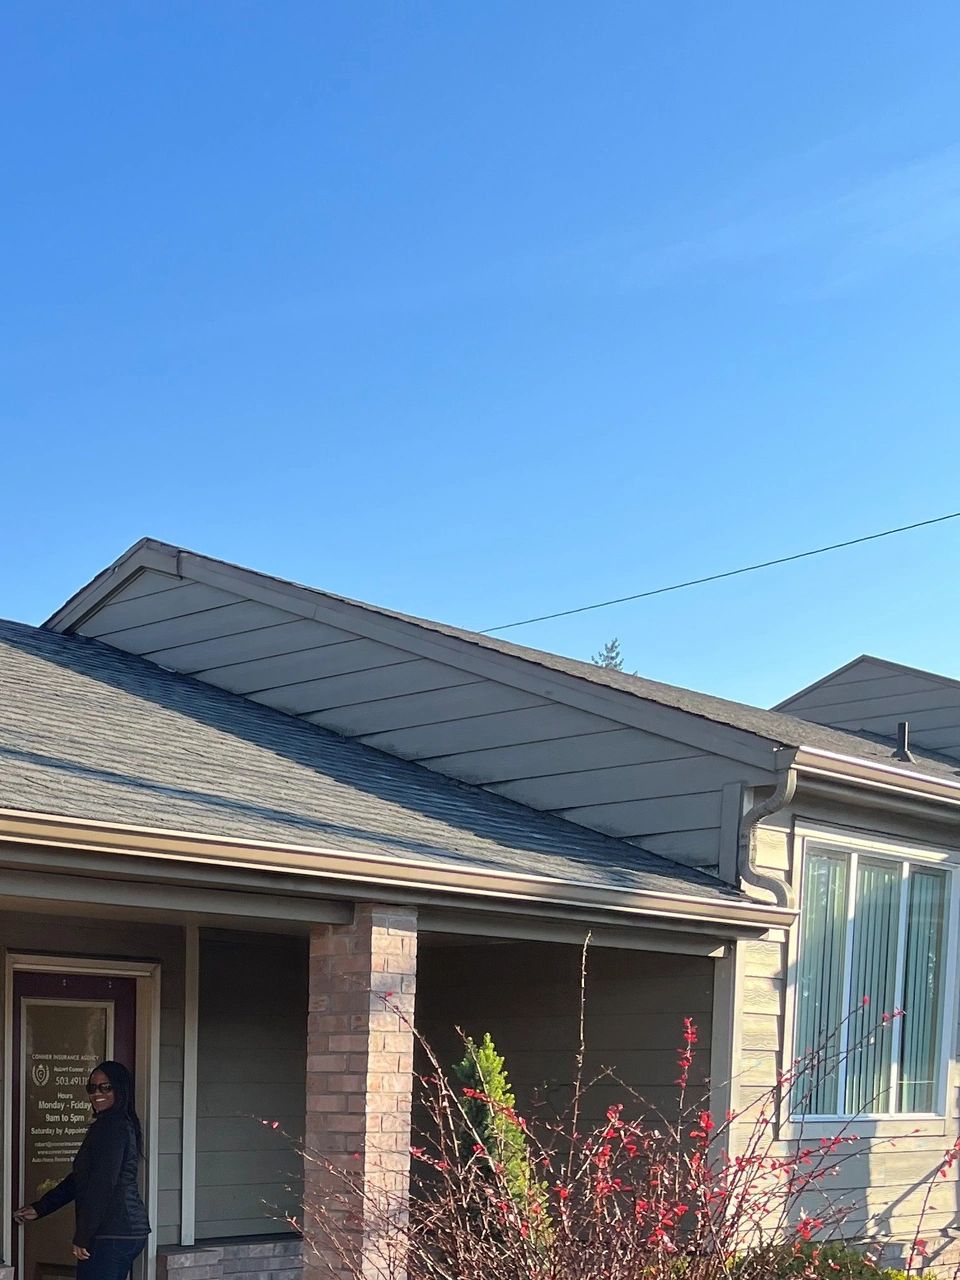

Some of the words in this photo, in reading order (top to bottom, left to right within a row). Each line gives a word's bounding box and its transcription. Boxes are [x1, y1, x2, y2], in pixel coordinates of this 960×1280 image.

[38, 1100, 65, 1111] Monday
[70, 1100, 92, 1111] Friday
[45, 1113, 60, 1122] 9am
[61, 1113, 69, 1122] to
[70, 1113, 85, 1124] 5pm
[30, 1127, 55, 1136] Saturday
[55, 1127, 63, 1136] by
